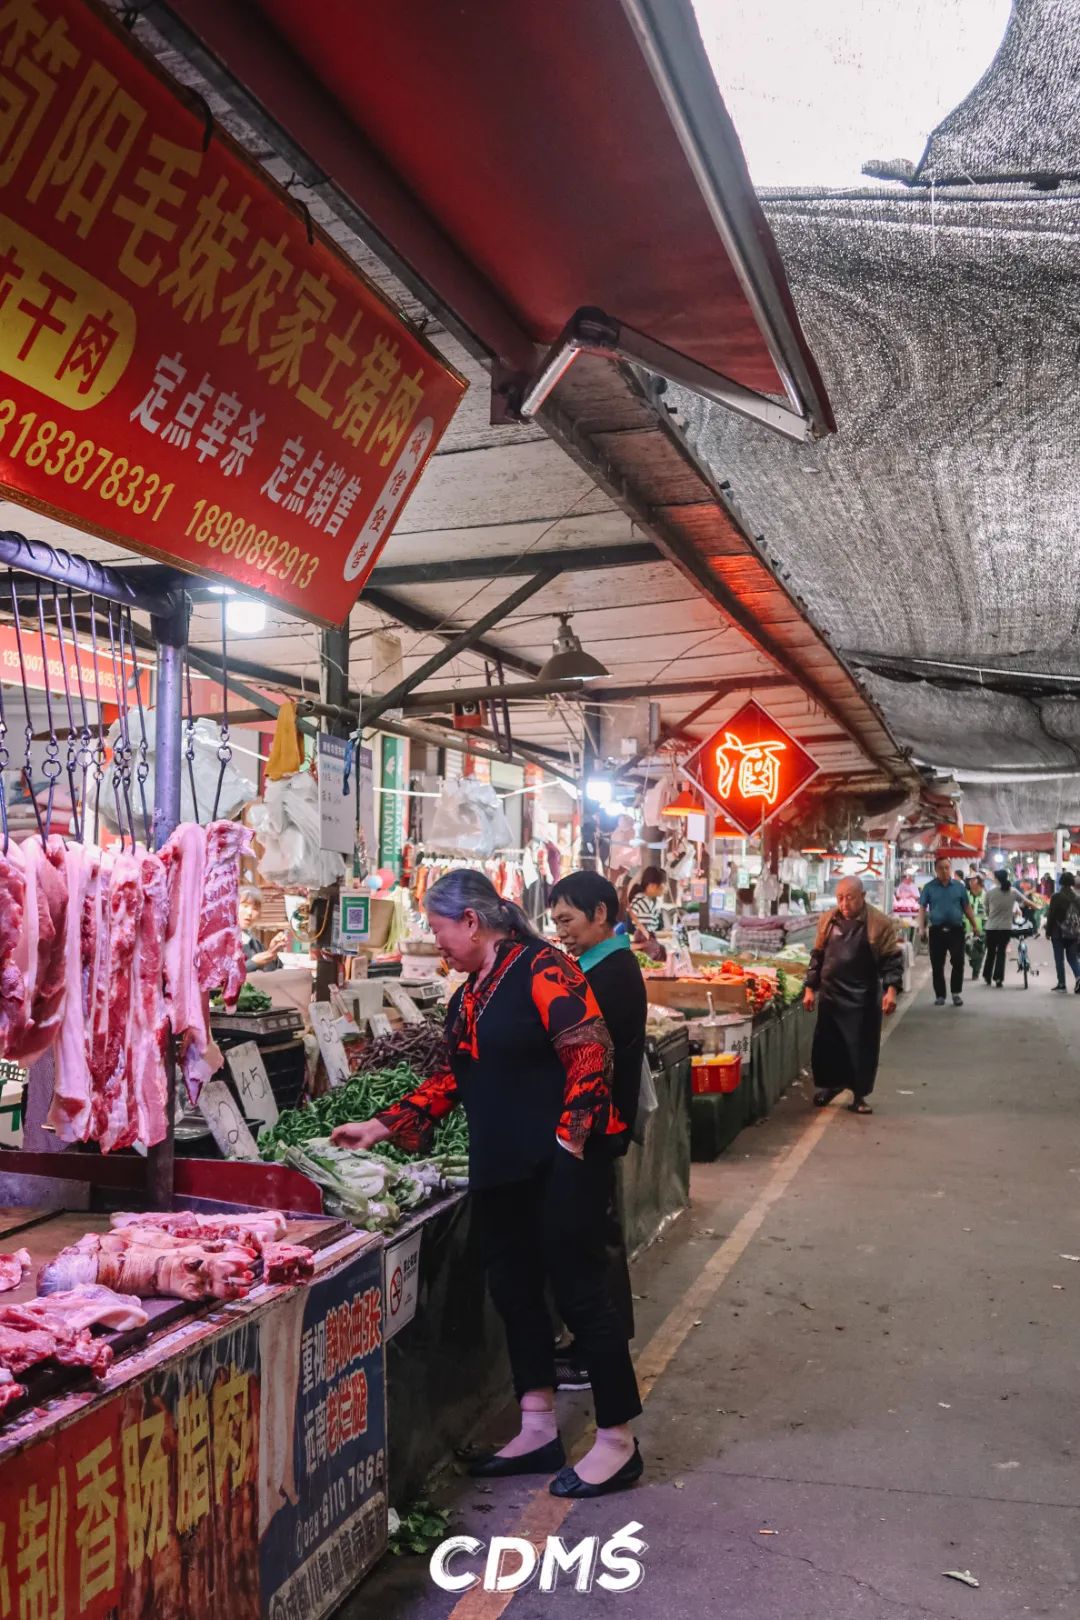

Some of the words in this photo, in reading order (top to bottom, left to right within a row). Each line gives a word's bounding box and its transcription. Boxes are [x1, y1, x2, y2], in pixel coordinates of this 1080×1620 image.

[129, 351, 266, 477] 定点宰杀
[259, 435, 363, 538] 定点销售
[184, 499, 320, 589] 18980892913
[715, 731, 786, 805] 酒
[301, 1286, 383, 1396] 重视静脉曲张
[0, 1359, 250, 1620] 制香肠腊肉
